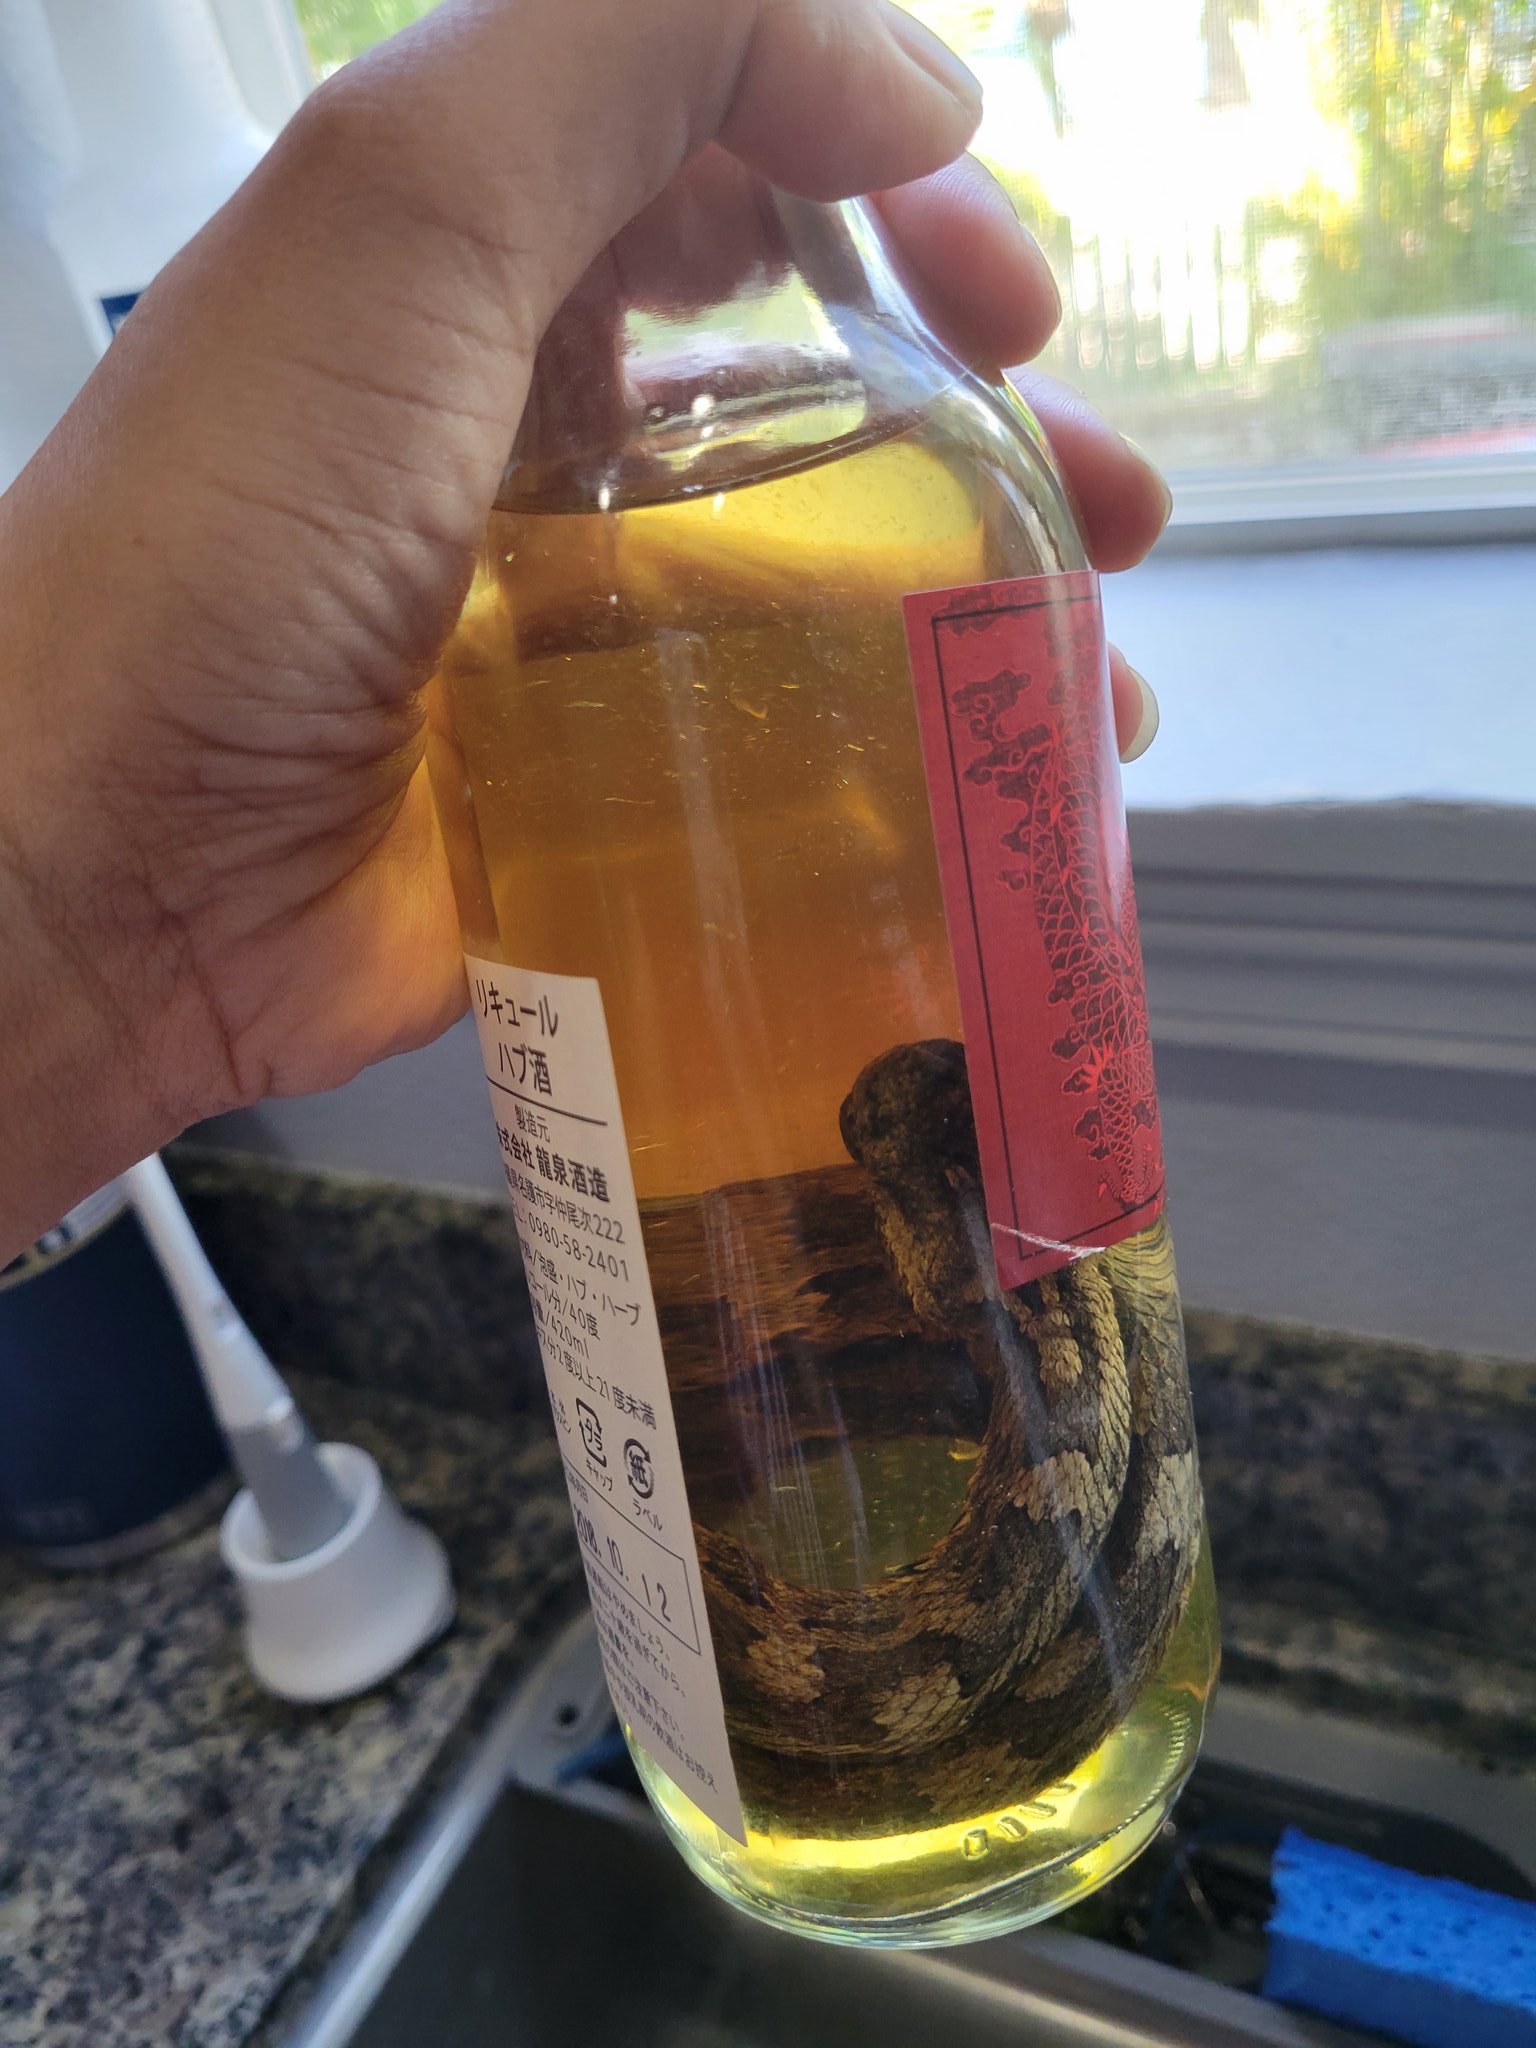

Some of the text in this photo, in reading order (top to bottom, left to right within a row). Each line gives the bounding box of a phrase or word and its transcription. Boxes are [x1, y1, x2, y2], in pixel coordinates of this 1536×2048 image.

[475, 979, 559, 1038] リキュール
[498, 1042, 553, 1096] ハブ酒
[513, 1104, 551, 1143] 製造元
[535, 1145, 611, 1203] 龍泉酒造
[528, 1212, 629, 1282] 0980-58-2401
[632, 1498, 664, 1532] ラベル
